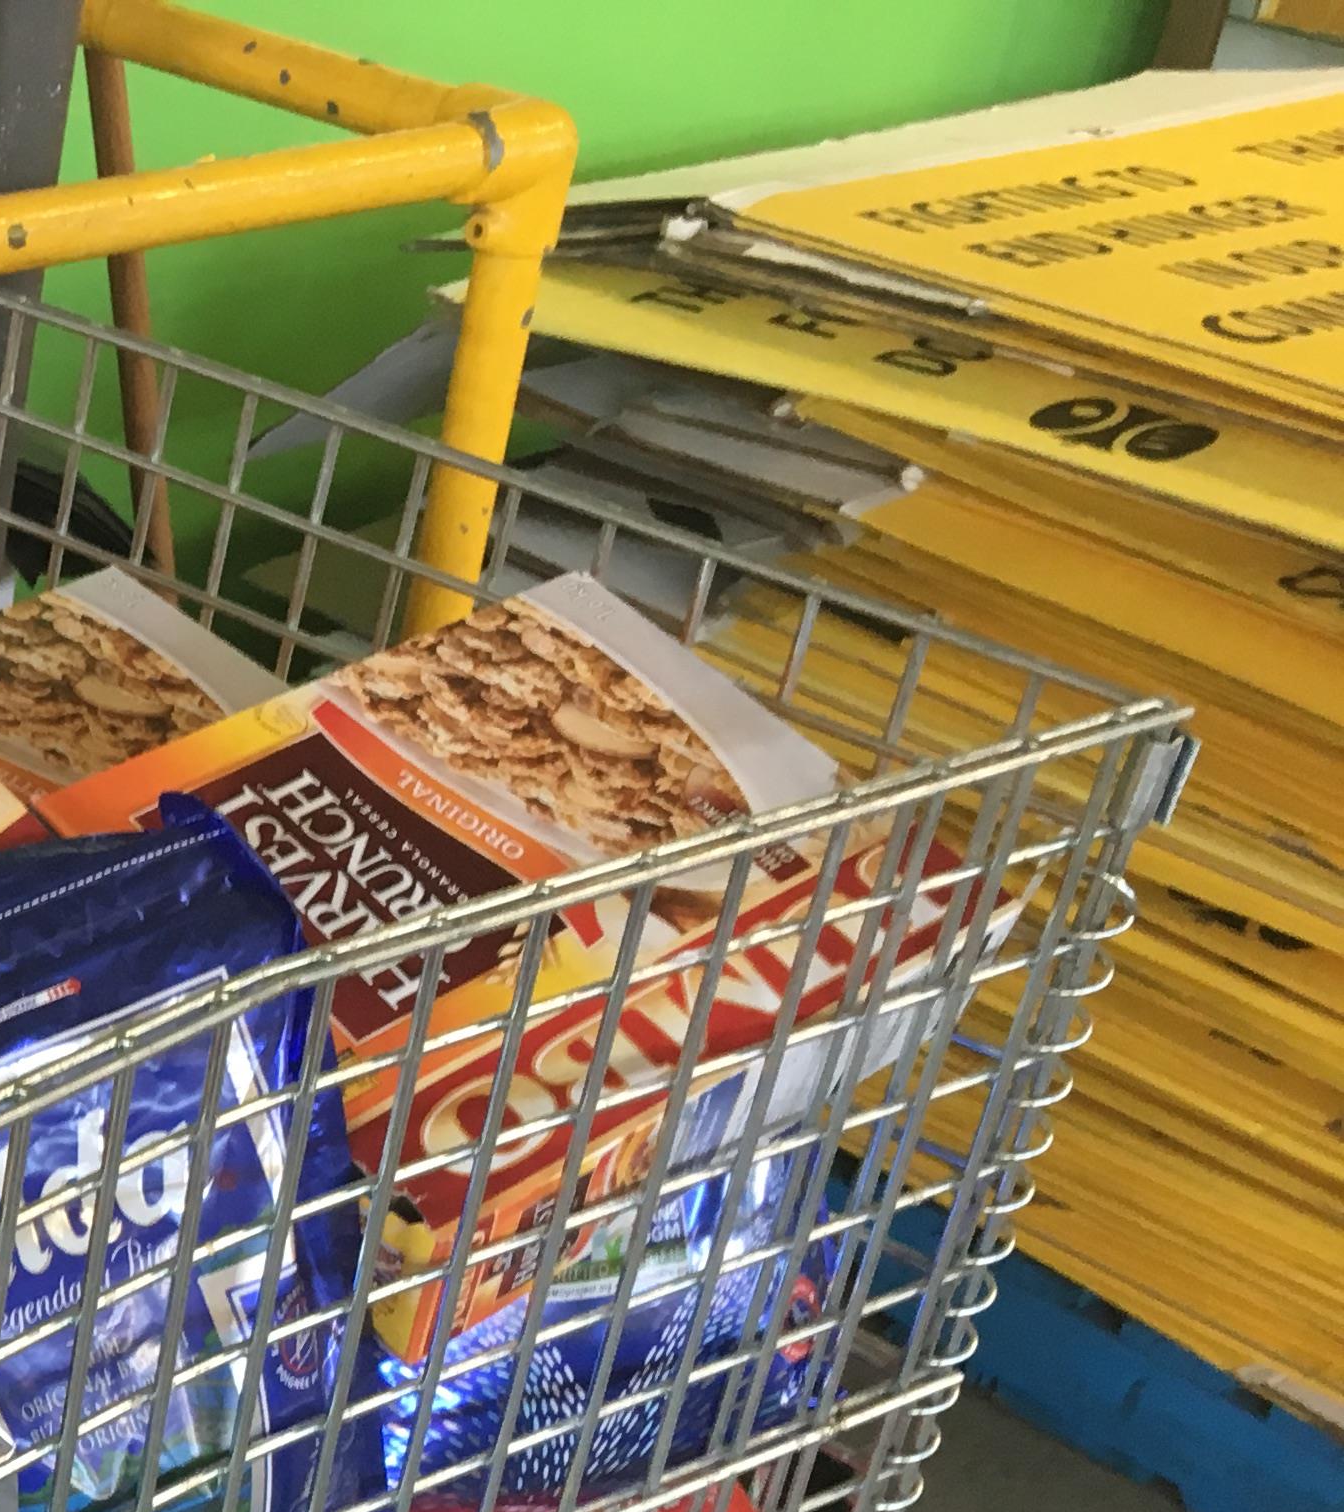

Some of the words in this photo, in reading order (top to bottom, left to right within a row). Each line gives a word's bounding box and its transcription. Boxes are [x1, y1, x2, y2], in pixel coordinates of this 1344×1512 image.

[857, 175, 1136, 233] FIGHTING
[1092, 164, 1198, 193] TO
[965, 230, 1114, 268] END
[1076, 194, 1326, 249] HUNGER
[344, 788, 398, 841] CEREAL
[397, 768, 525, 861] ORIGINAL
[263, 767, 472, 955] RUNCH
[20, 1367, 112, 1422] ORIGNAL
